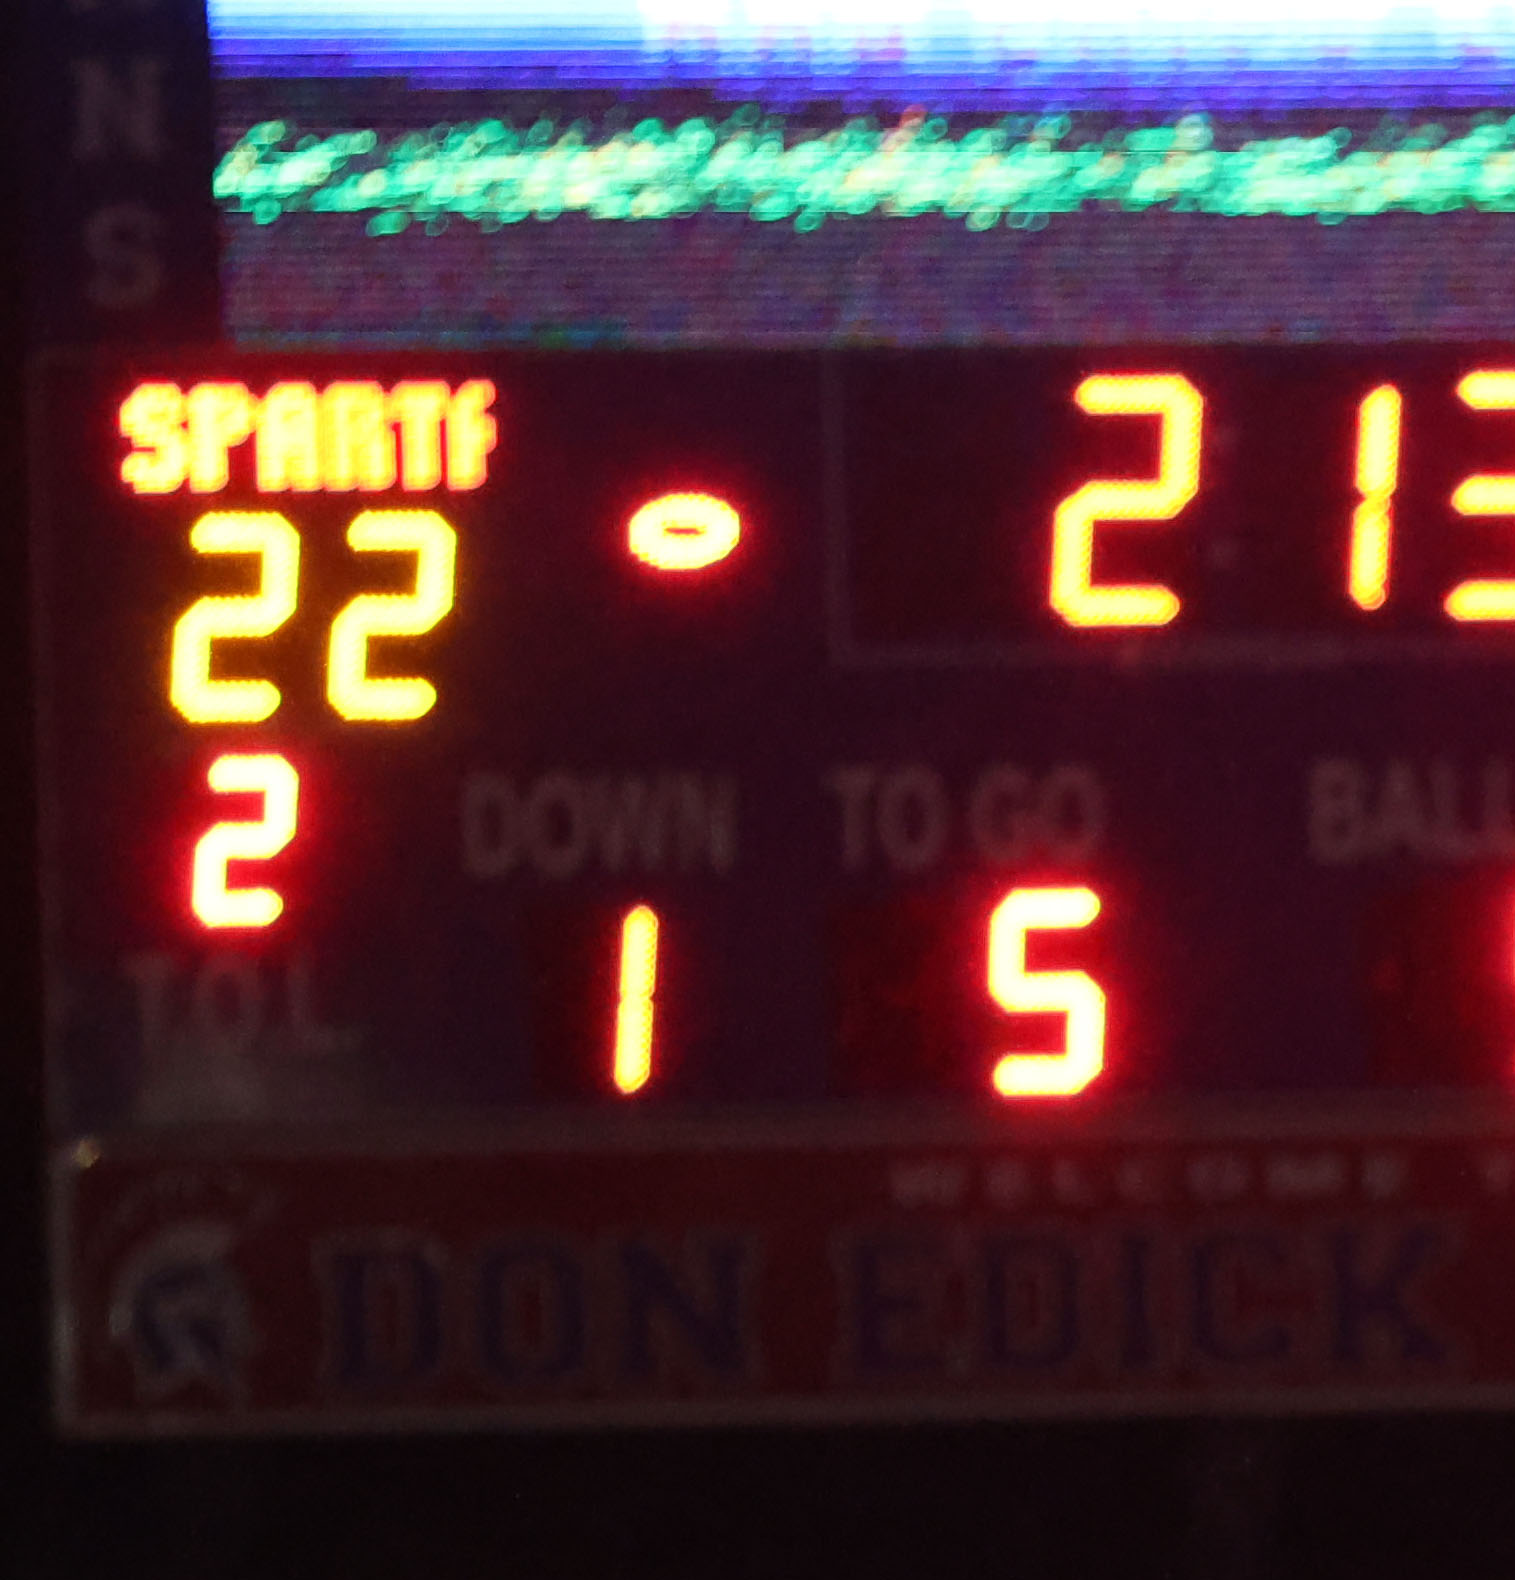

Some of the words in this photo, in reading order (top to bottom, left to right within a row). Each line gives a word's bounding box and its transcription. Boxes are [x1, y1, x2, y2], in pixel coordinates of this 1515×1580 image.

[167, 508, 459, 726] 22
[190, 751, 300, 929] 2
[462, 768, 740, 880] DOWN
[820, 762, 950, 873] TO
[966, 760, 1106, 866] GO
[614, 905, 659, 1094] 1
[987, 885, 1107, 1098] 5
[312, 1224, 770, 1390] DON
[828, 1208, 1464, 1386] EDICK
